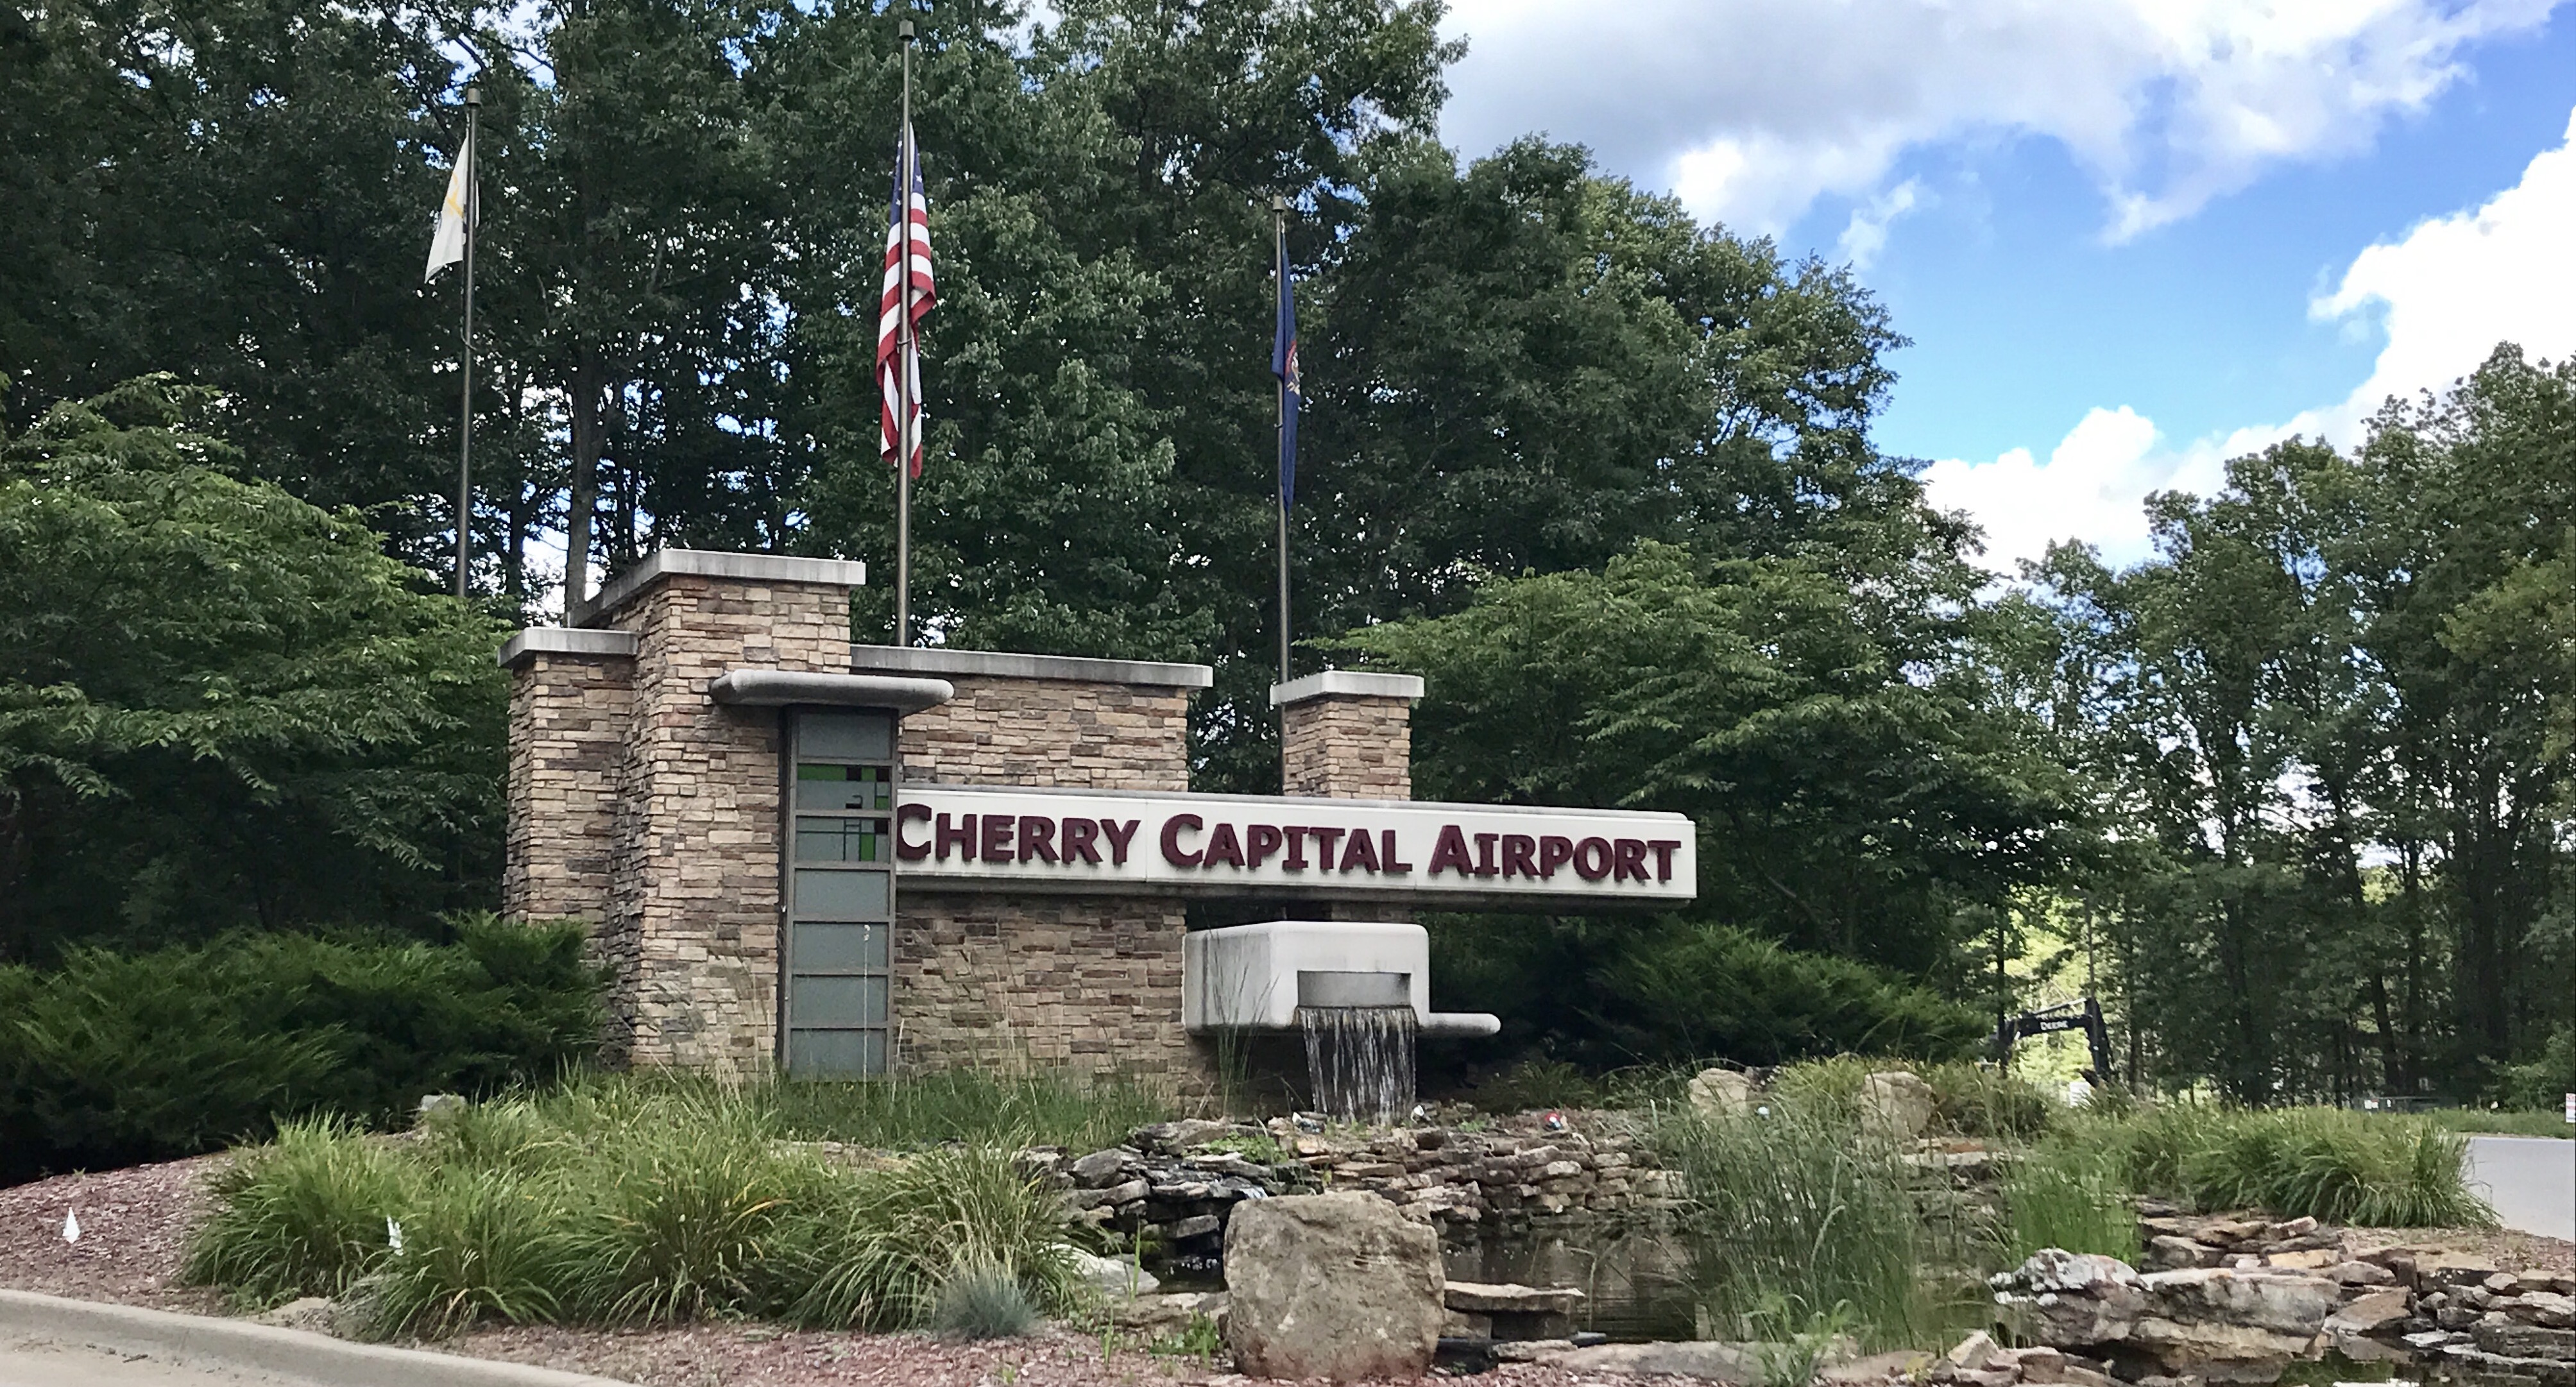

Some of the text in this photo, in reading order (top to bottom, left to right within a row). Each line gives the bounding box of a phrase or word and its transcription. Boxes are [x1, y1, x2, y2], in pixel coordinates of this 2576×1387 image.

[897, 803, 1681, 881] CHERRY CAPITAL AIRPORT
[2040, 1021, 2068, 1030] DEERE
